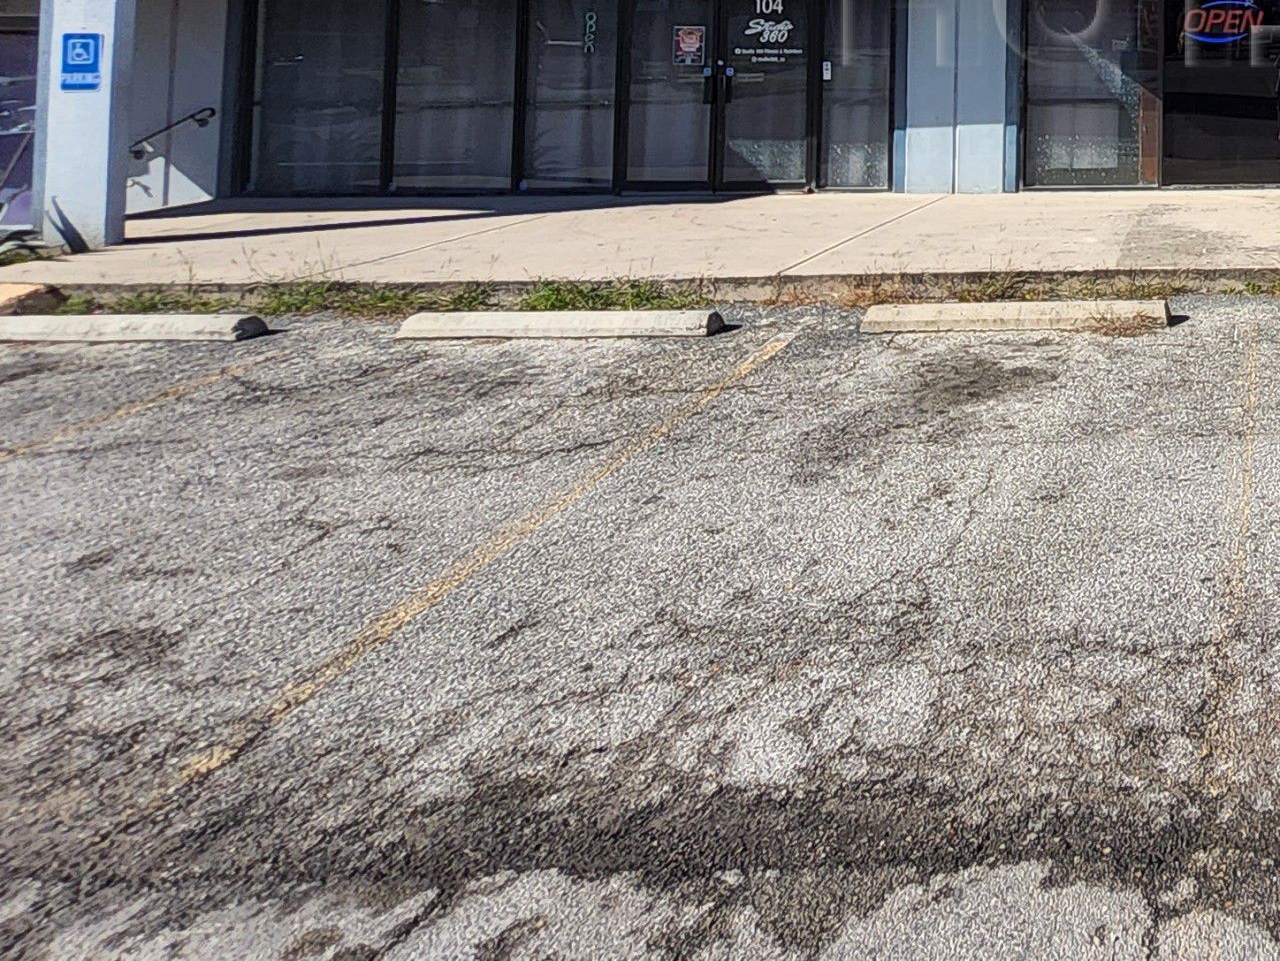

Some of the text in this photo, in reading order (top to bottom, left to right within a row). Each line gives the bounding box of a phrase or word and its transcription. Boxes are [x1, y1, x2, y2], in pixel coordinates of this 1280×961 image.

[744, 18, 794, 35] Studio
[1184, 9, 1265, 35] OPEN
[759, 30, 788, 43] 360
